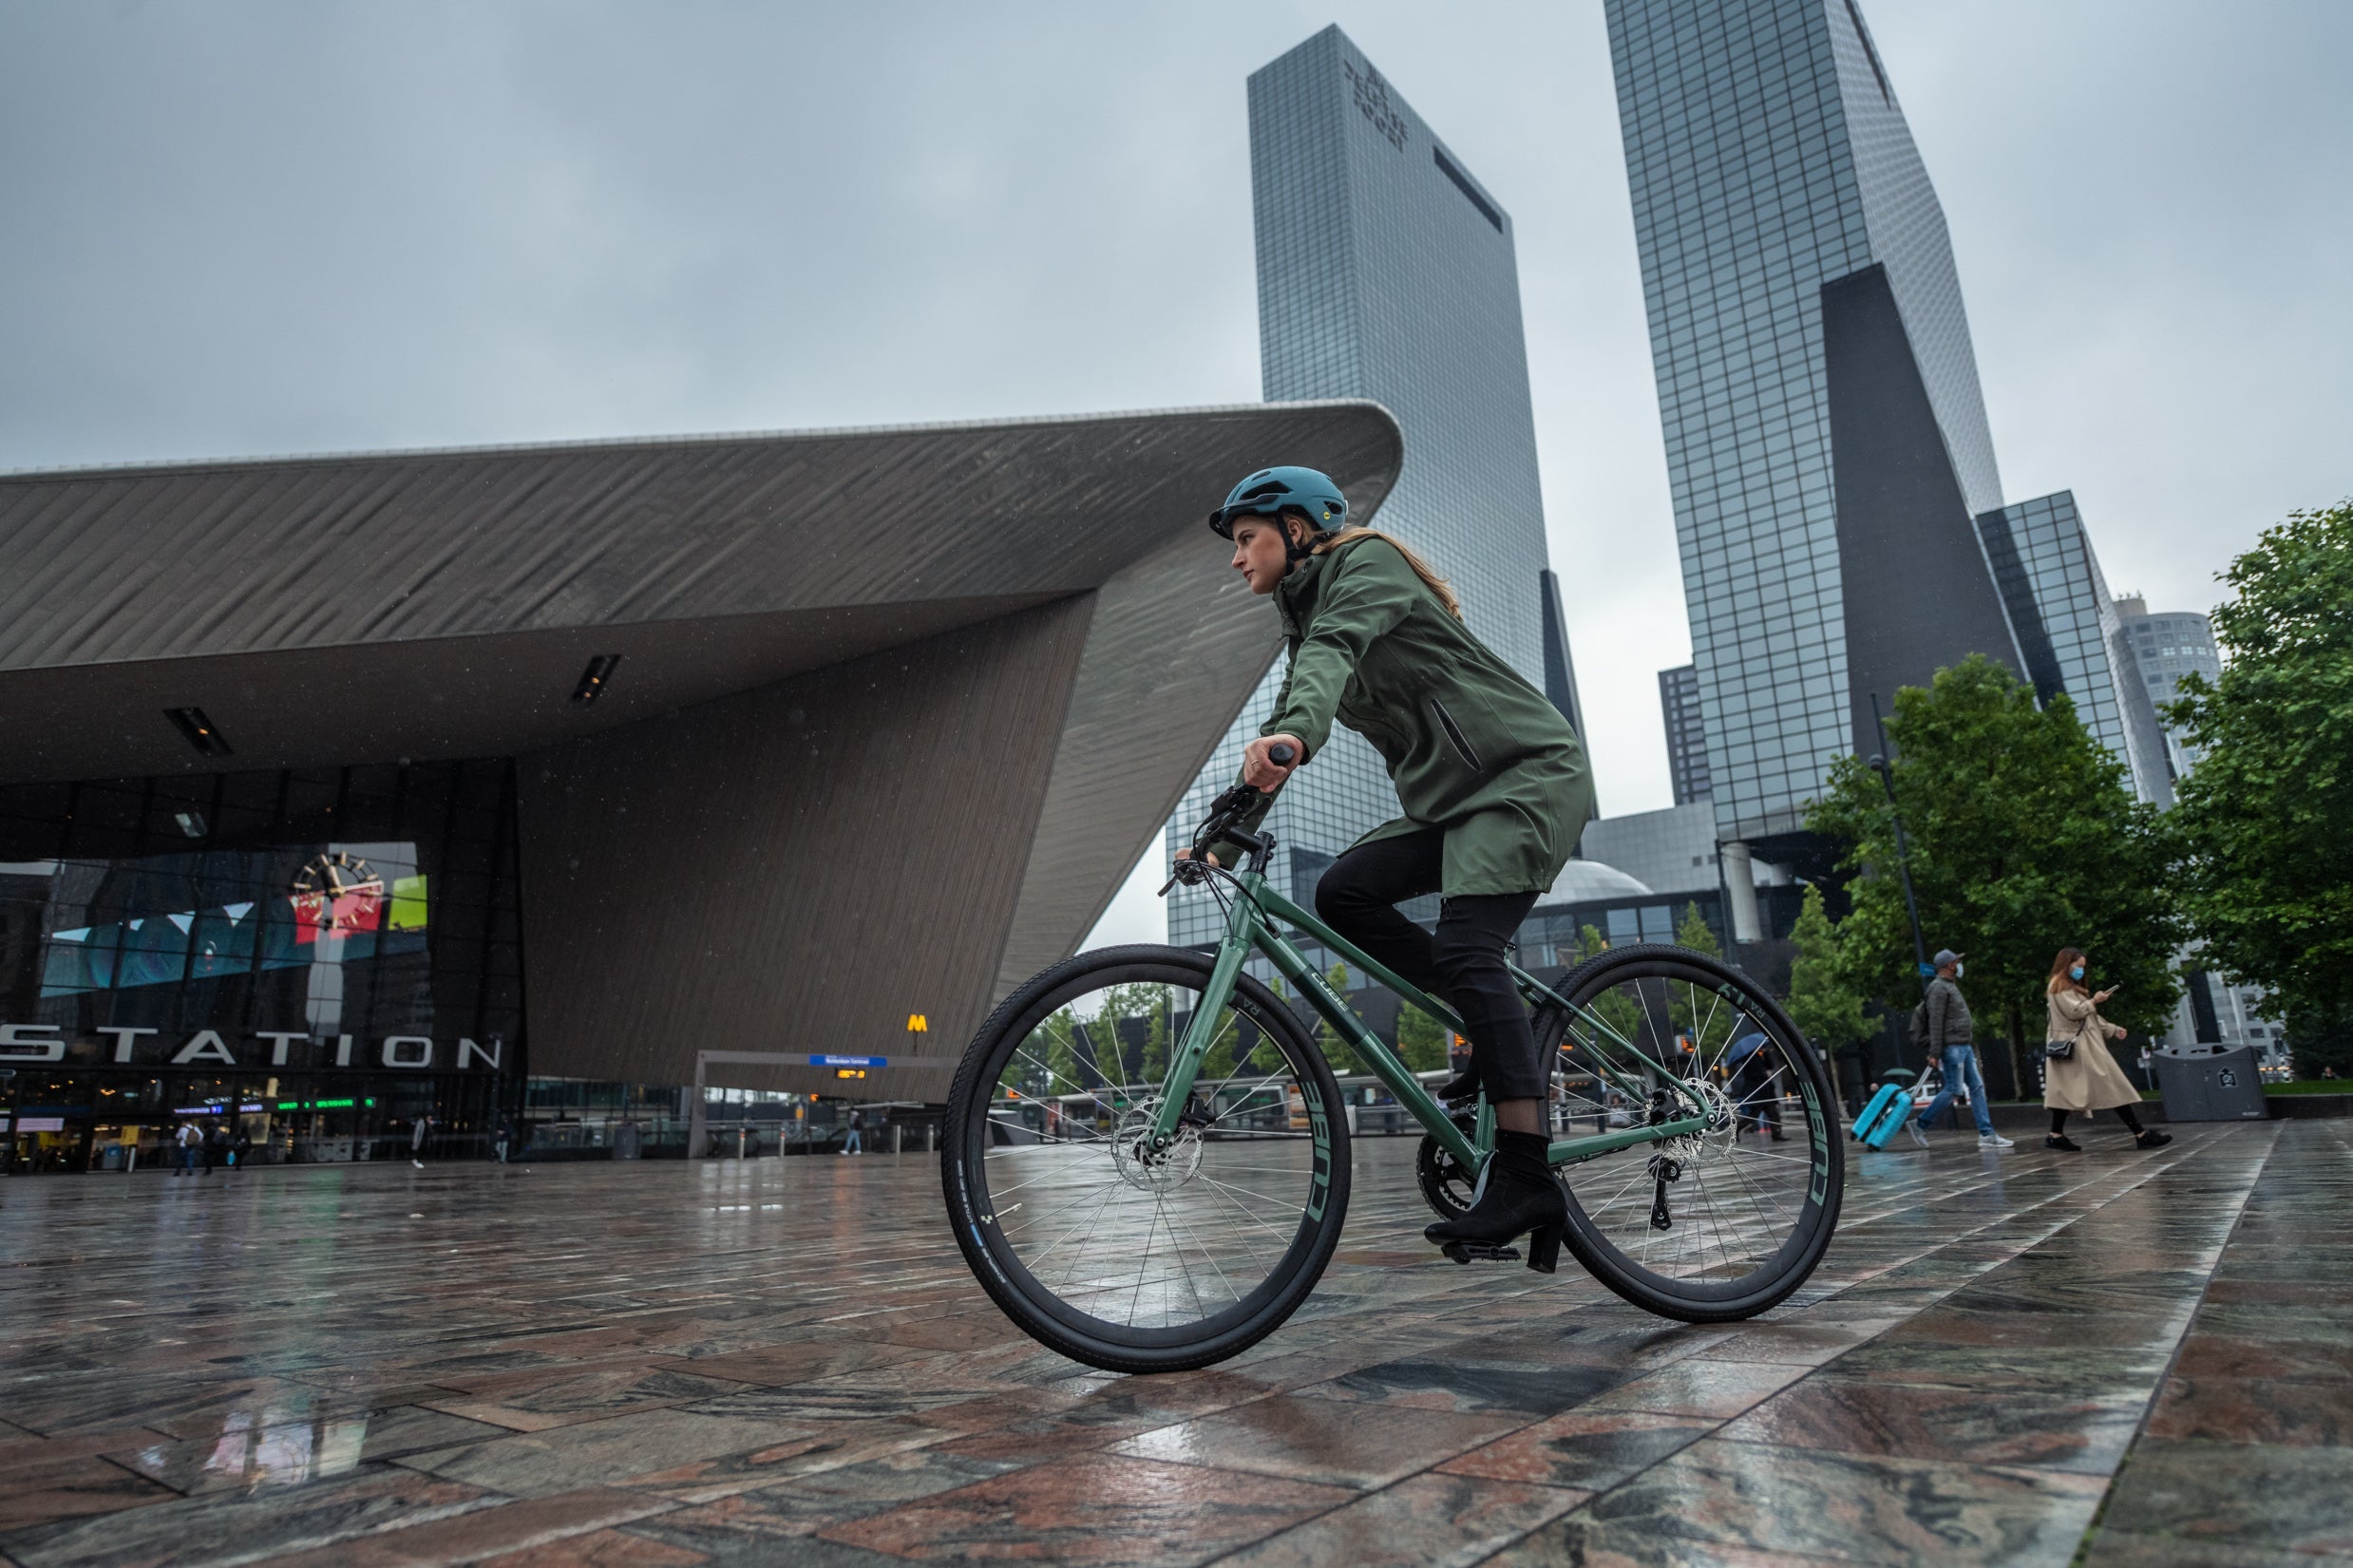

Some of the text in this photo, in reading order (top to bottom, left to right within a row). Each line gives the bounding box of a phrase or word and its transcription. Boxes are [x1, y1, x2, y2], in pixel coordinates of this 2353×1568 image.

[1311, 972, 1349, 1011] CUBE
[907, 1014, 927, 1031] M
[0, 1023, 502, 1069] STATION
[1300, 1081, 1331, 1222] CUBE
[1798, 1082, 1830, 1207] CUBE
